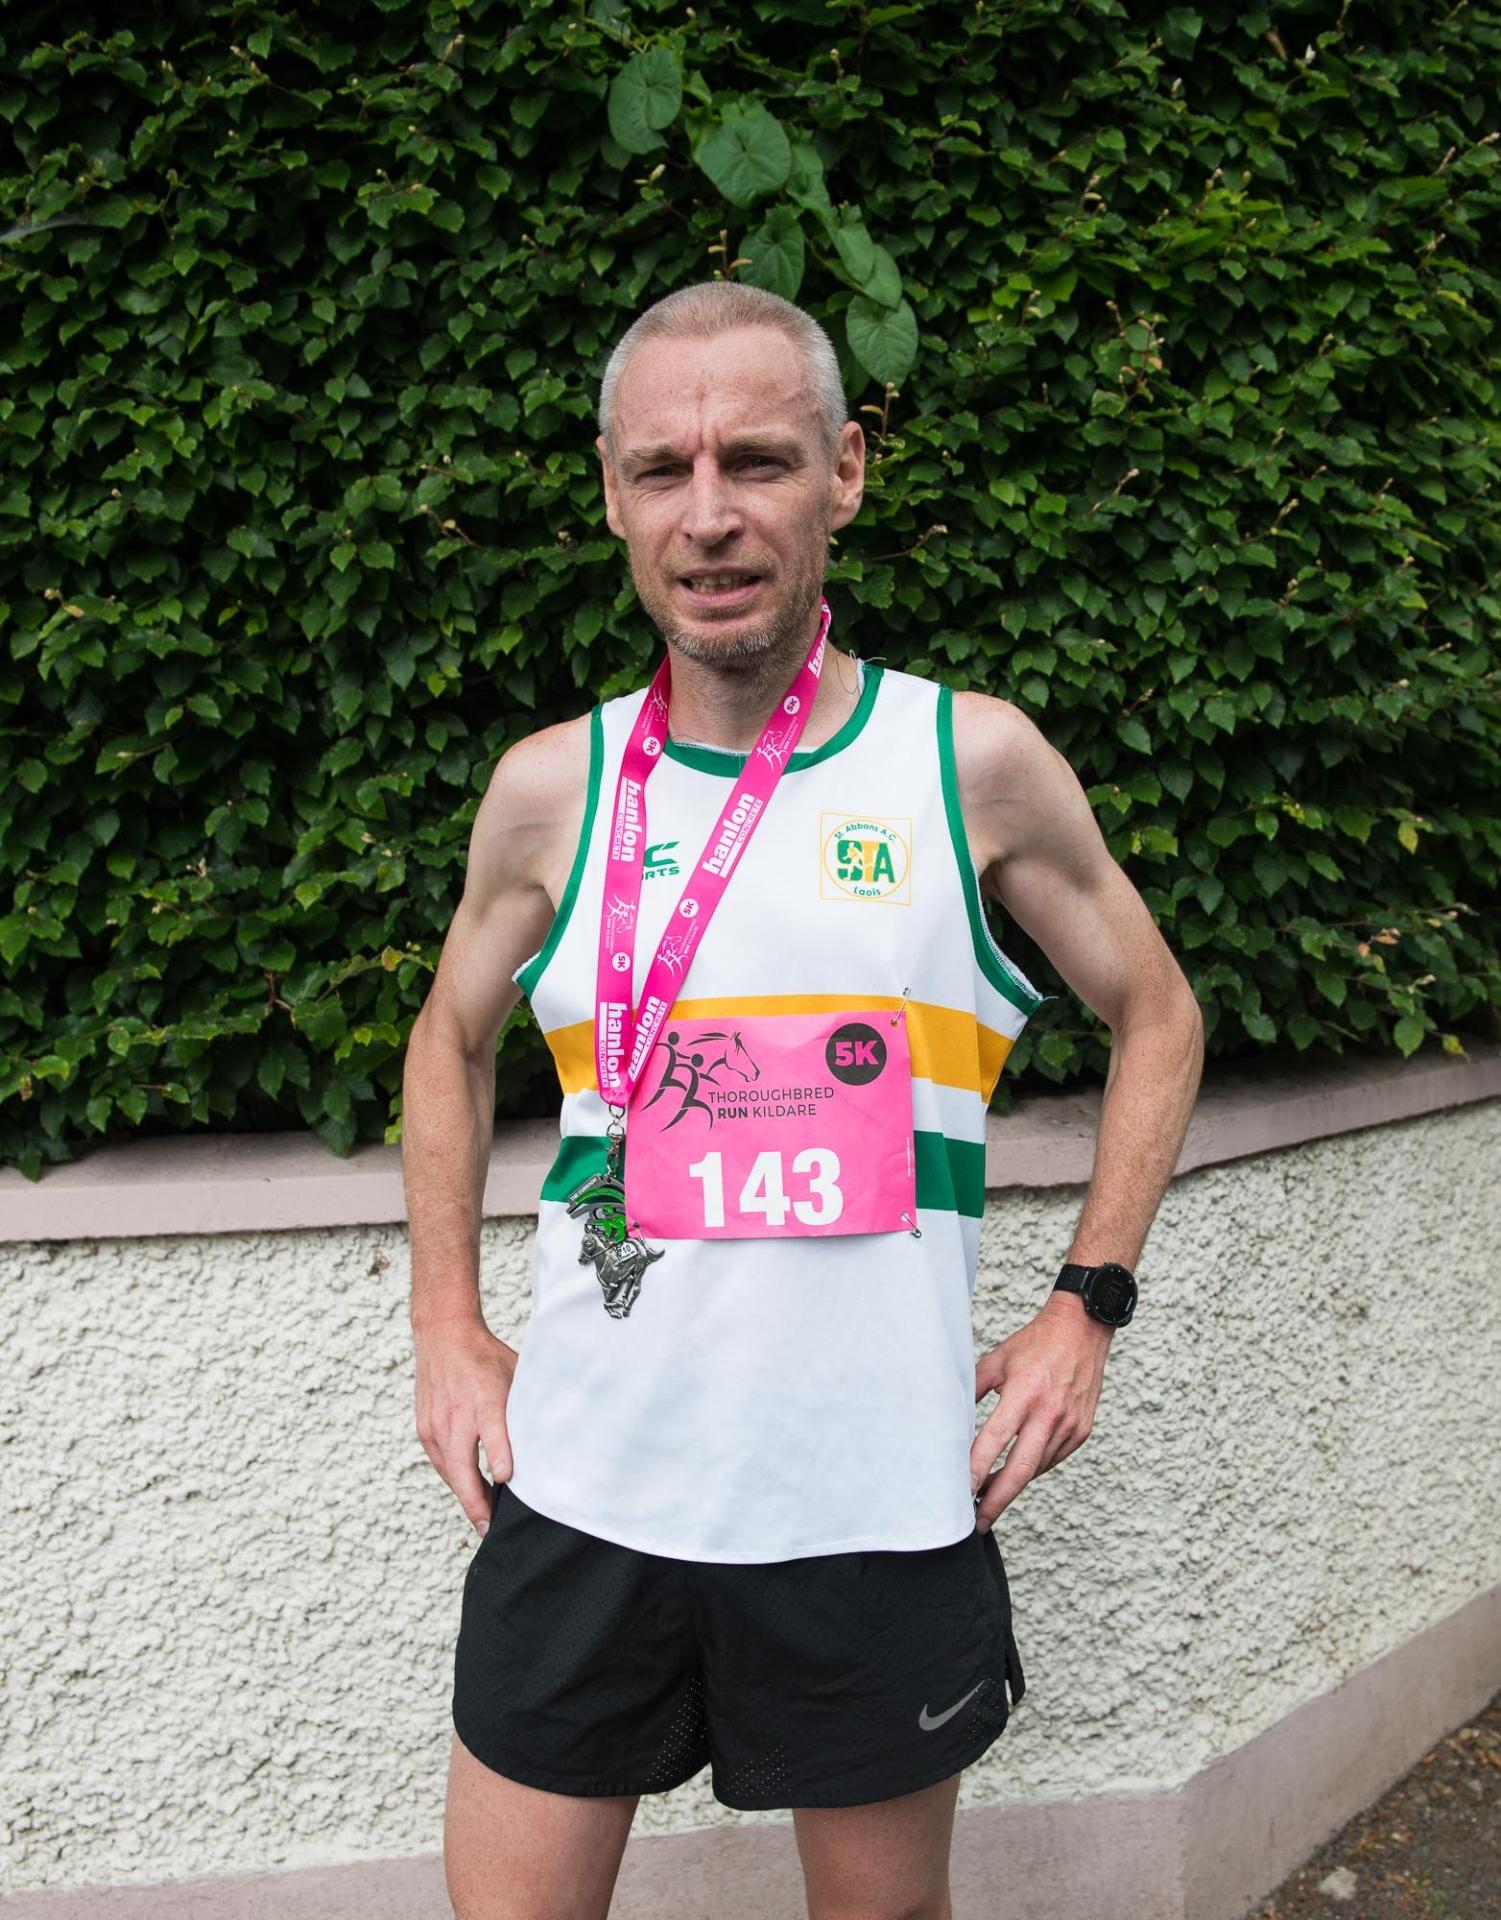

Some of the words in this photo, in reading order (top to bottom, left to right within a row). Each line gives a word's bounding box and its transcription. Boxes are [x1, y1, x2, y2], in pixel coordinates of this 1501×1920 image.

[620, 779, 642, 862] hanlon
[702, 793, 756, 875] hanlon
[643, 866, 680, 880] RTS
[853, 886, 881, 896] Laois
[682, 902, 695, 915] 5K
[607, 1003, 628, 1088] hanlon
[835, 1041, 879, 1066] 5K
[708, 1086, 834, 1104] THOROUGHBRED
[717, 1107, 748, 1119] RUN
[752, 1104, 817, 1118] KILDARE
[688, 1148, 844, 1228] 143
